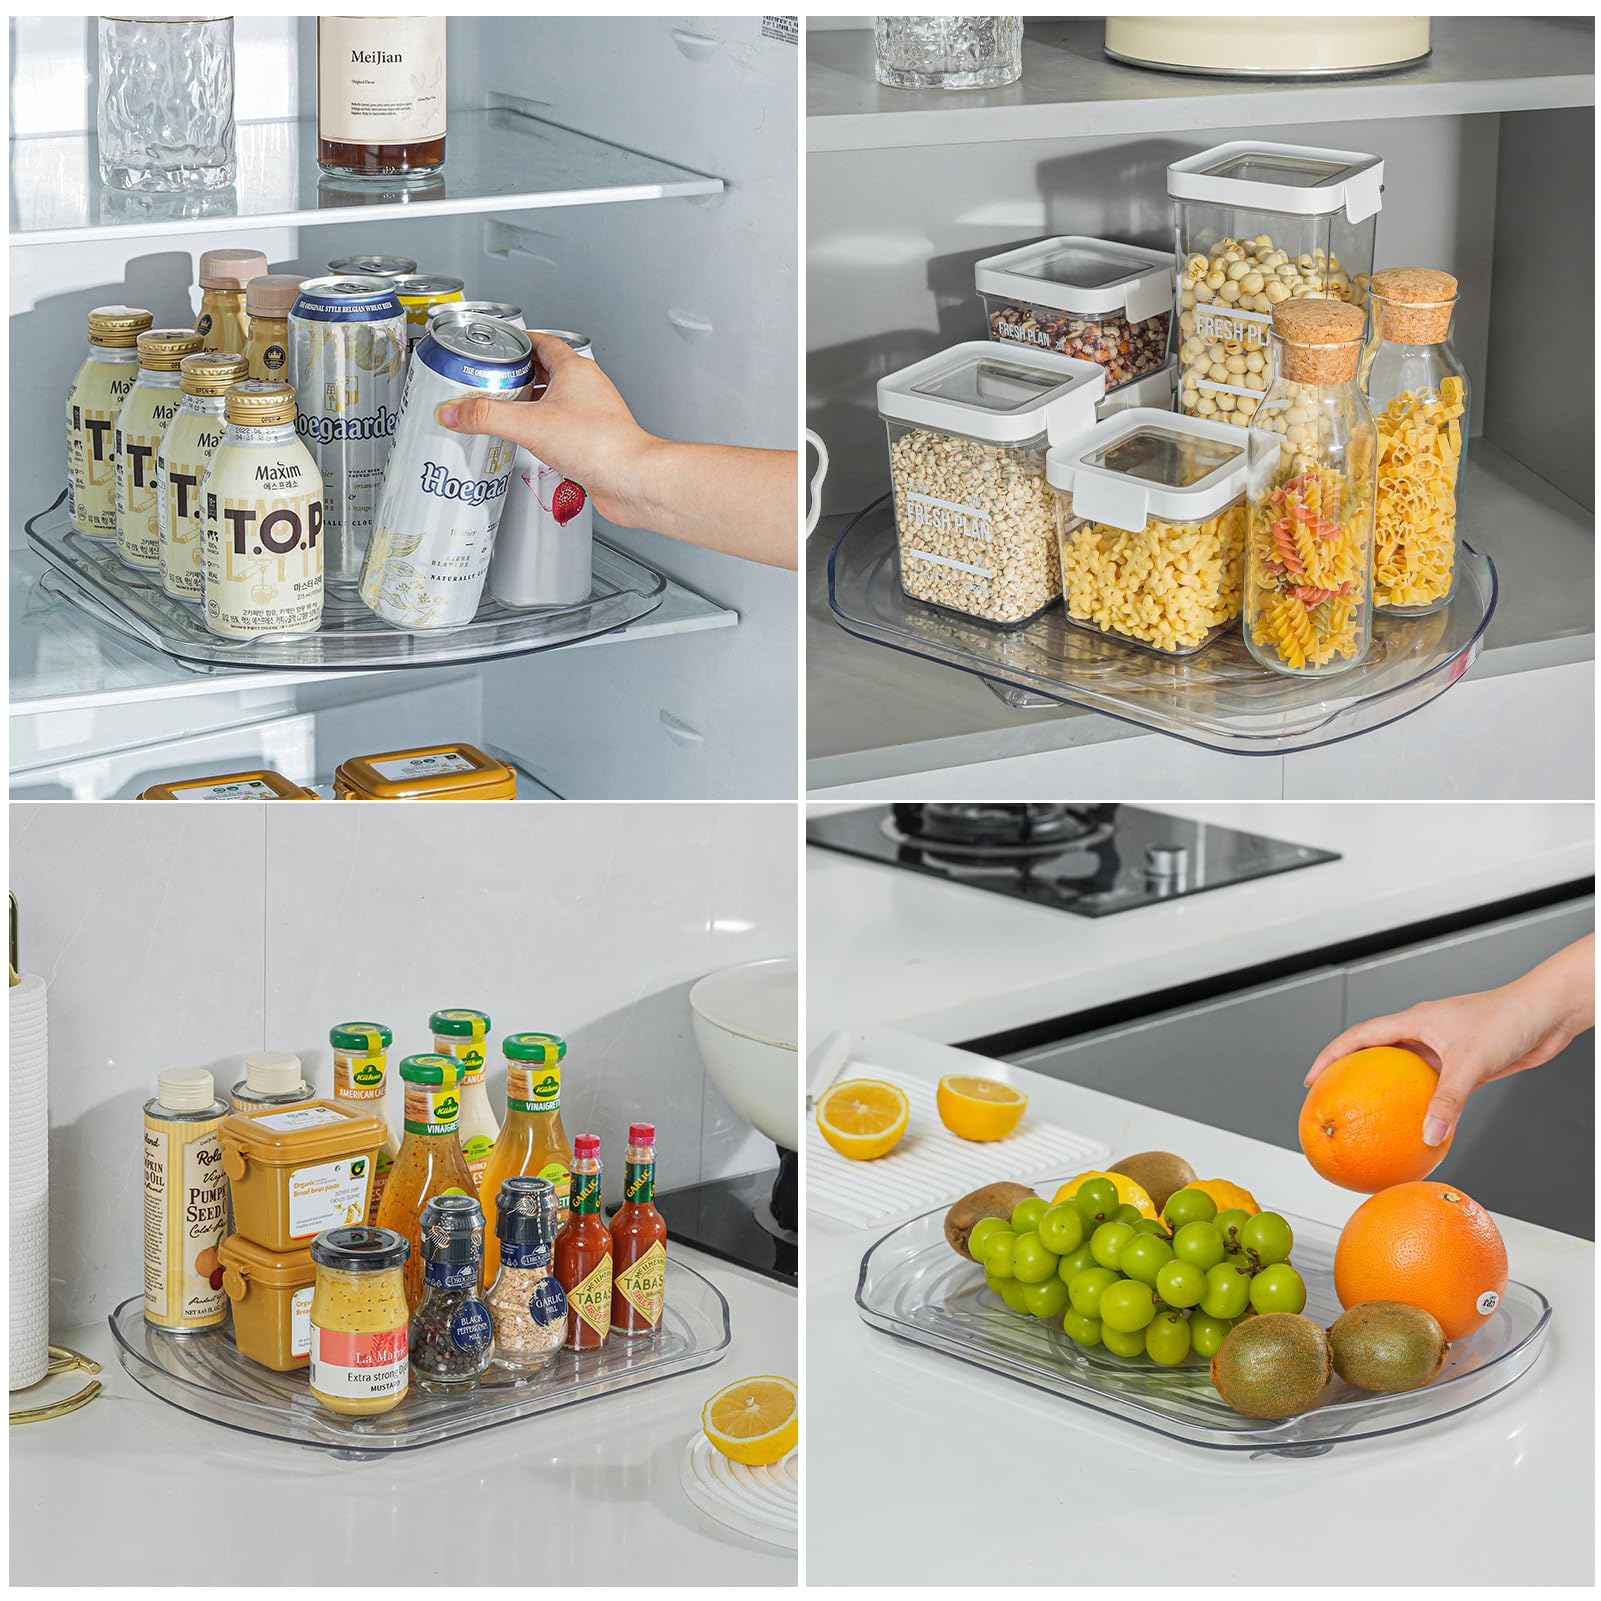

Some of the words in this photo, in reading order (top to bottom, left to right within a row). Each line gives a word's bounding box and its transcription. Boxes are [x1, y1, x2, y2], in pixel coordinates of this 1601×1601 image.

[351, 49, 403, 66] MeiJian
[999, 321, 1026, 340] FRESH
[1027, 328, 1050, 347] PLAN
[1196, 316, 1244, 343] FRESH
[254, 461, 302, 481] Maxim
[421, 461, 512, 506] Hoegaa
[906, 502, 951, 531] FRESH
[954, 513, 991, 543] PLAN
[430, 573, 476, 582] NATURALLY
[340, 1087, 374, 1099] AMERICAN
[293, 1179, 315, 1191] Organic
[293, 1188, 311, 1198] Broad
[311, 1185, 324, 1194] bean
[325, 1183, 340, 1193] paste
[626, 1168, 652, 1198] GARLIC
[571, 1178, 599, 1207] GARLIC
[187, 1205, 221, 1222] SEED
[535, 1292, 563, 1308] GARLIC
[461, 1313, 483, 1326] BLACK
[356, 1352, 371, 1364] La
[347, 1372, 371, 1382] Extra
